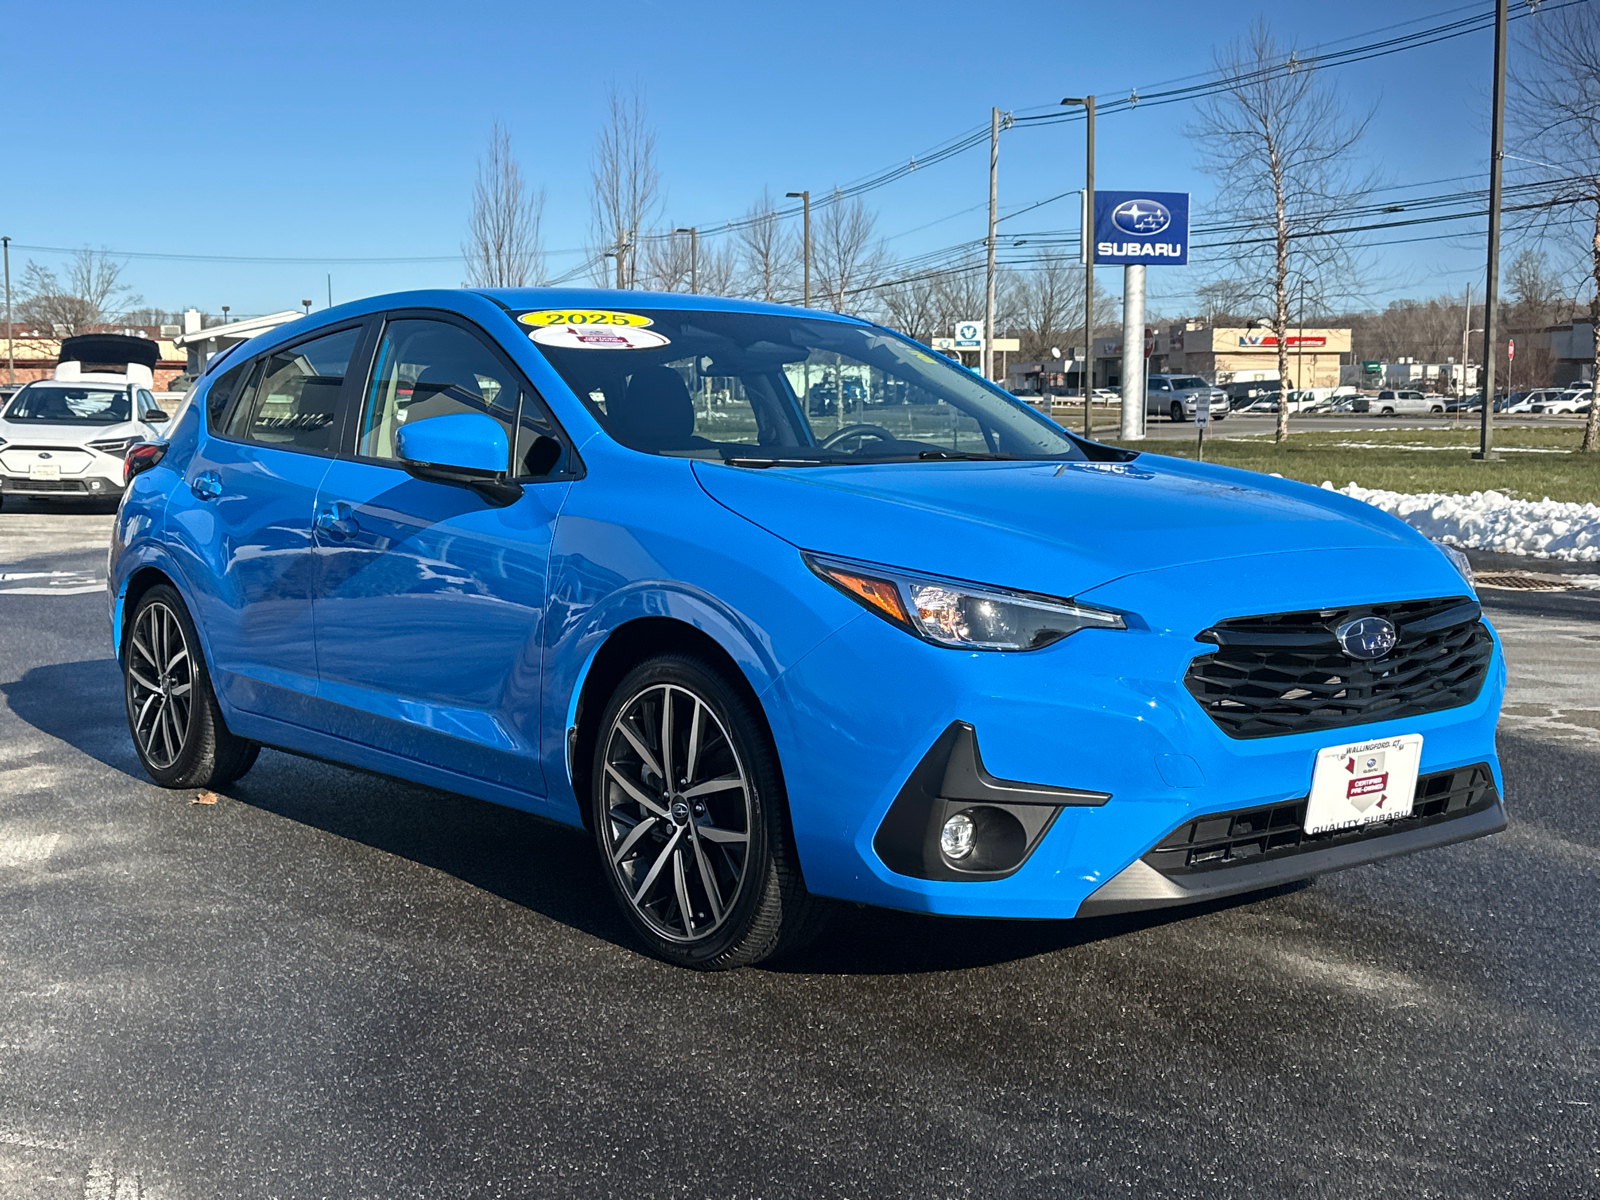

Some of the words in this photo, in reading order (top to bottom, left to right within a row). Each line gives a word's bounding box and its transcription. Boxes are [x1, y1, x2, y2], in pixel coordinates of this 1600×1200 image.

[1098, 242, 1181, 256] SUBARU
[546, 313, 630, 325] 2025
[1354, 777, 1382, 787] CERTIFIED
[1312, 818, 1360, 834] QUALITY
[1363, 810, 1409, 824] SUBARU
